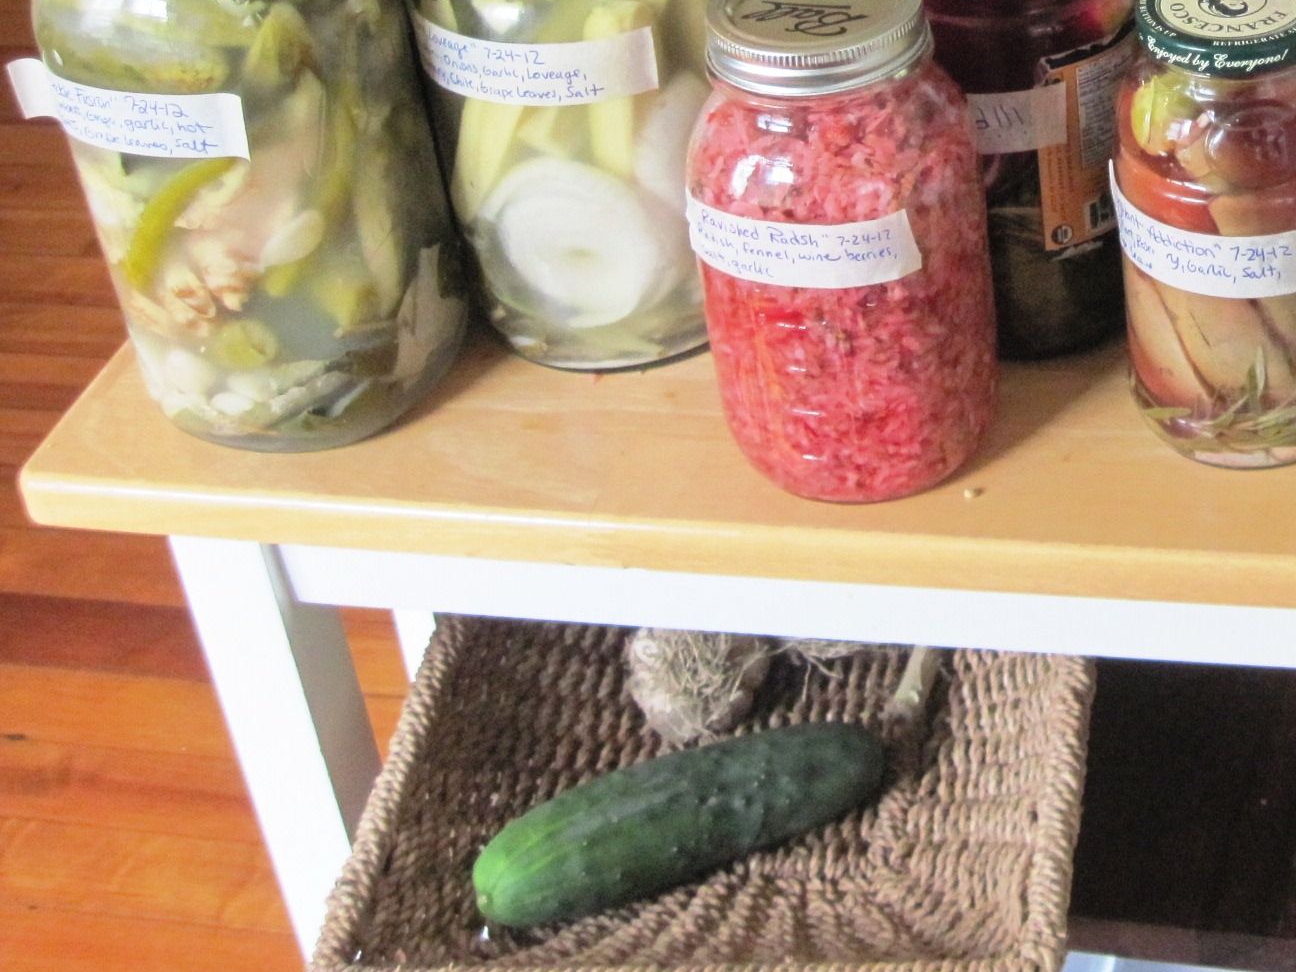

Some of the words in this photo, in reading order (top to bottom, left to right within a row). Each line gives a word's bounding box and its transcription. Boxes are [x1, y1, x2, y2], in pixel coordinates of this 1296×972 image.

[742, 0, 868, 37] Ball
[1169, 2, 1289, 34] FRANCESCO
[483, 45, 546, 65] 7-24-12
[1147, 35, 1190, 65] Enjoyed
[1193, 52, 1210, 72] by
[1213, 48, 1289, 72] Everyone!
[836, 229, 892, 246] 7-24-12
[799, 253, 841, 264] wine
[1230, 245, 1293, 262] 7-24-12
